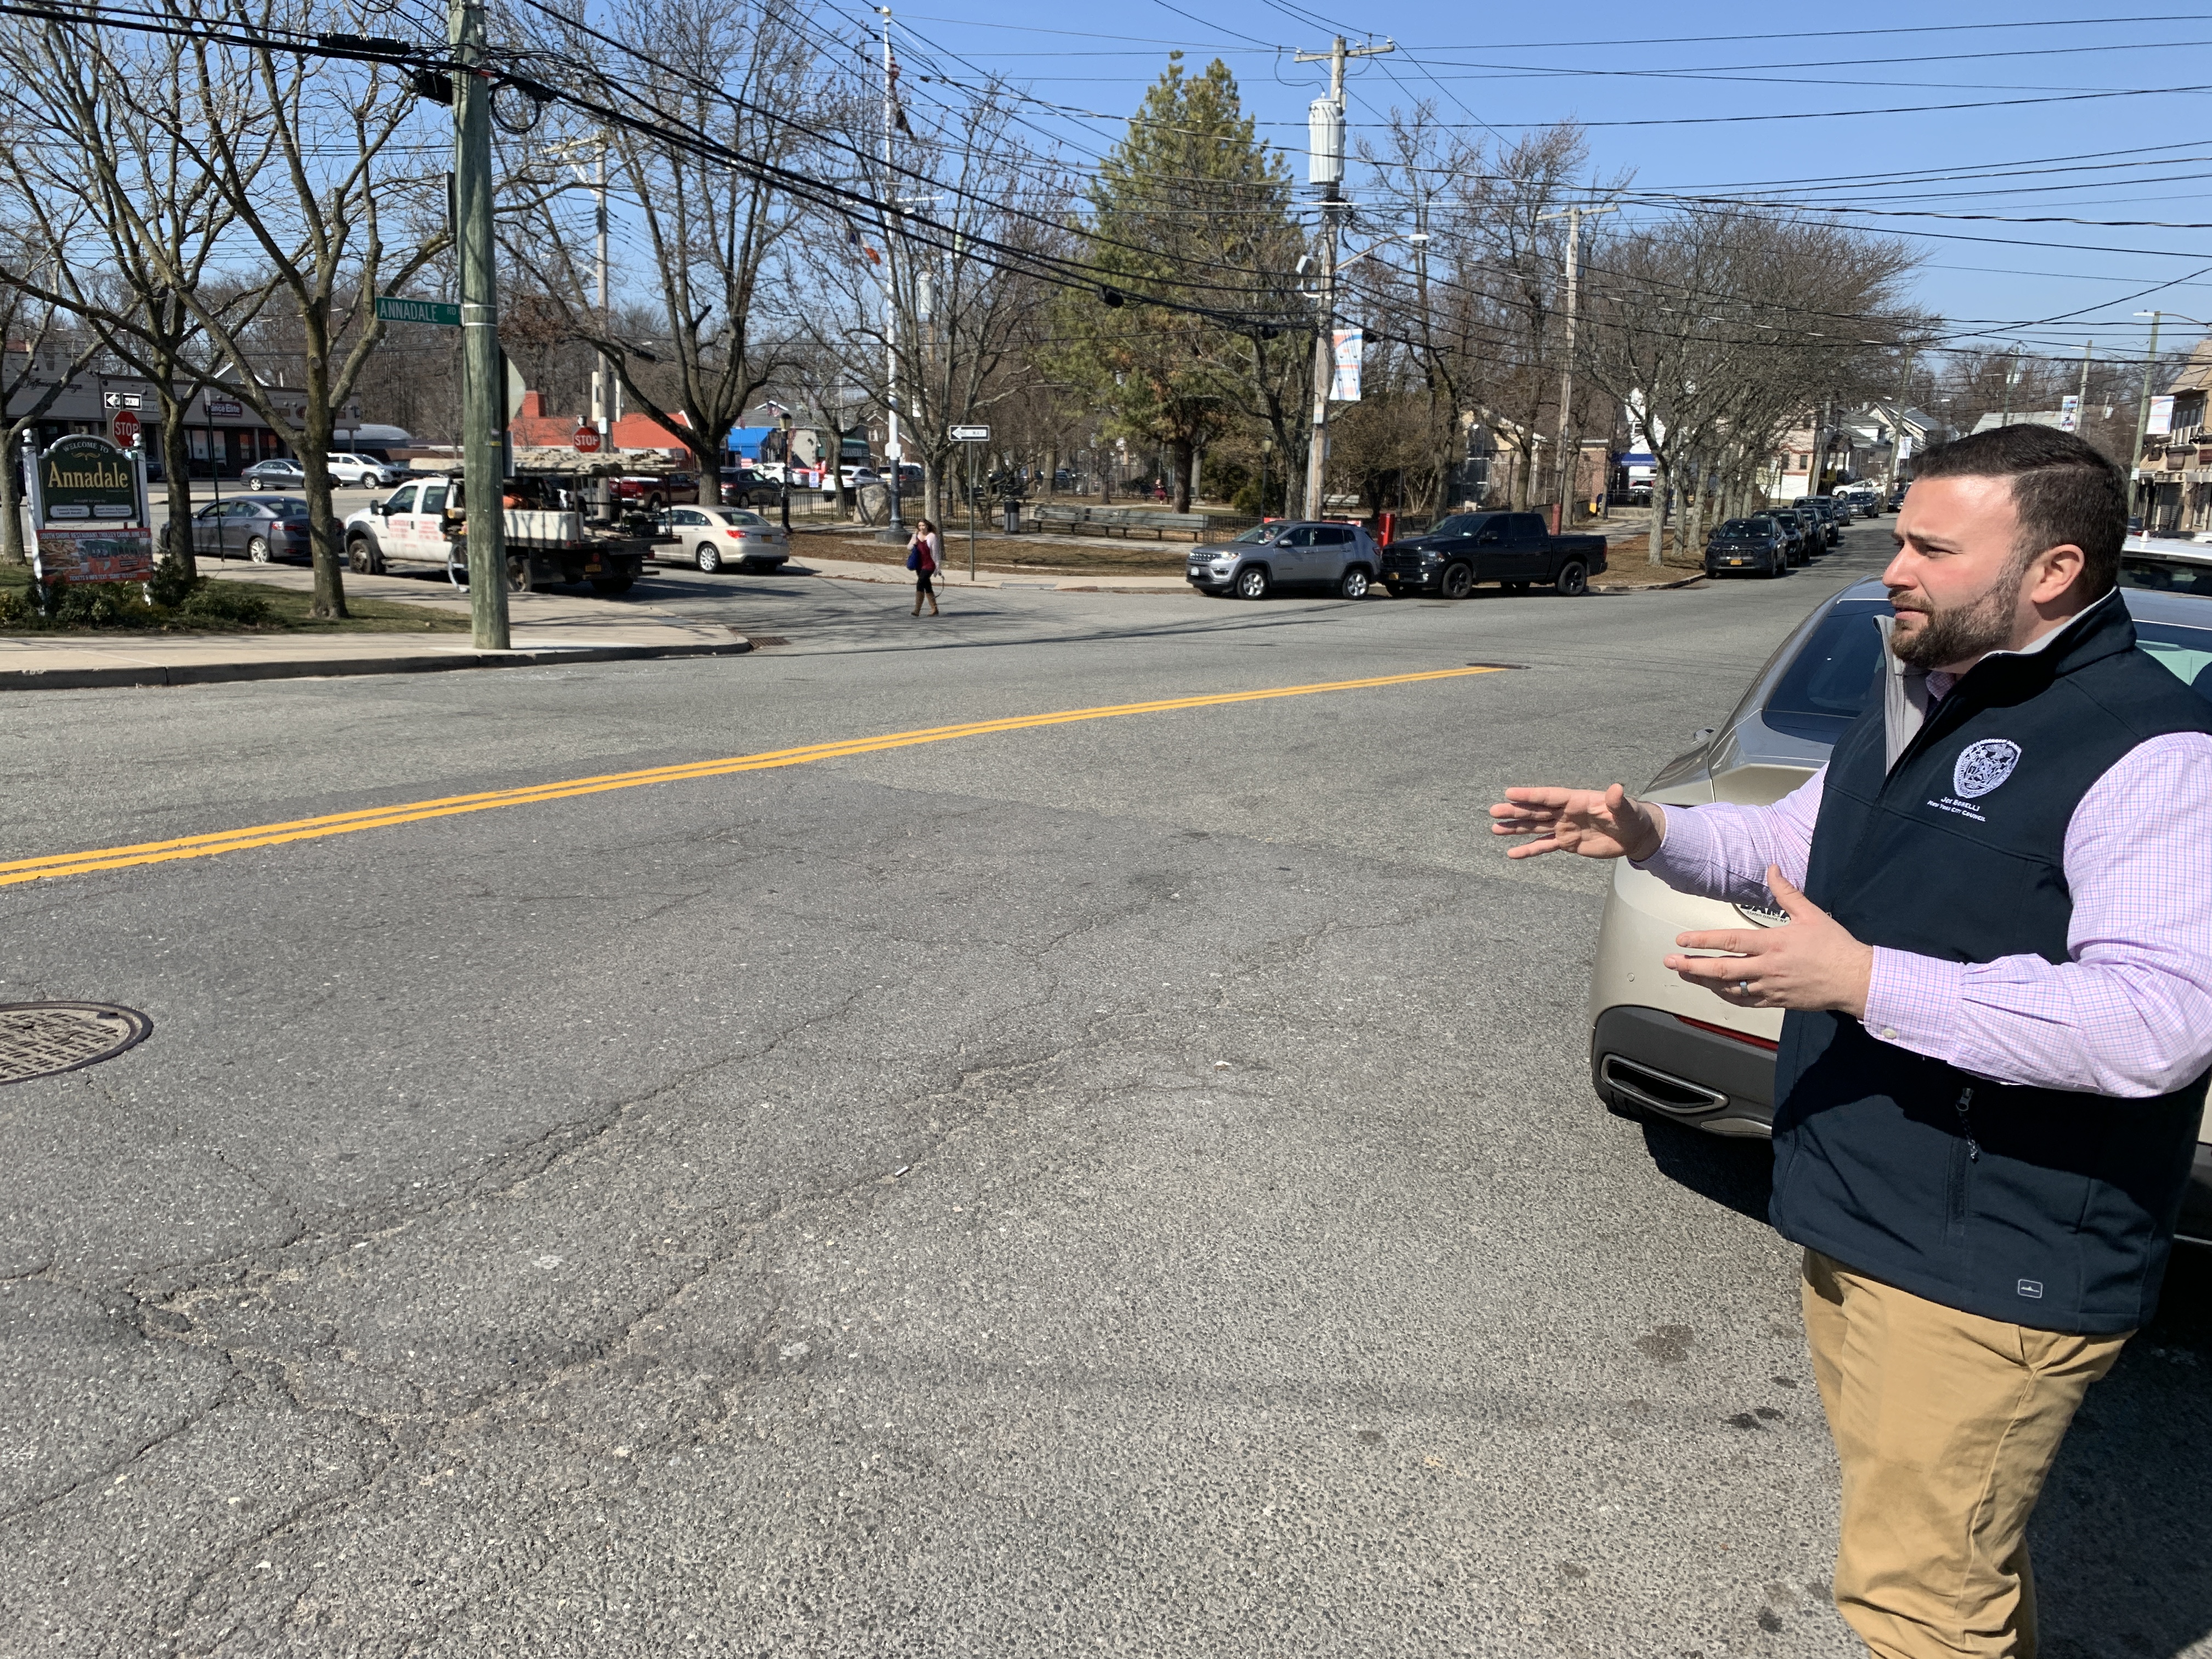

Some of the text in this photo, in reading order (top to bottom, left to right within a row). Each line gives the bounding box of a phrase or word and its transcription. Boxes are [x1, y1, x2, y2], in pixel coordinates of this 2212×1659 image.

[380, 300, 456, 321] ANNADALE RD
[115, 421, 139, 436] STOP
[63, 441, 109, 454] WELCOME TO
[574, 435, 599, 446] STOP
[47, 460, 128, 488] Annadale
